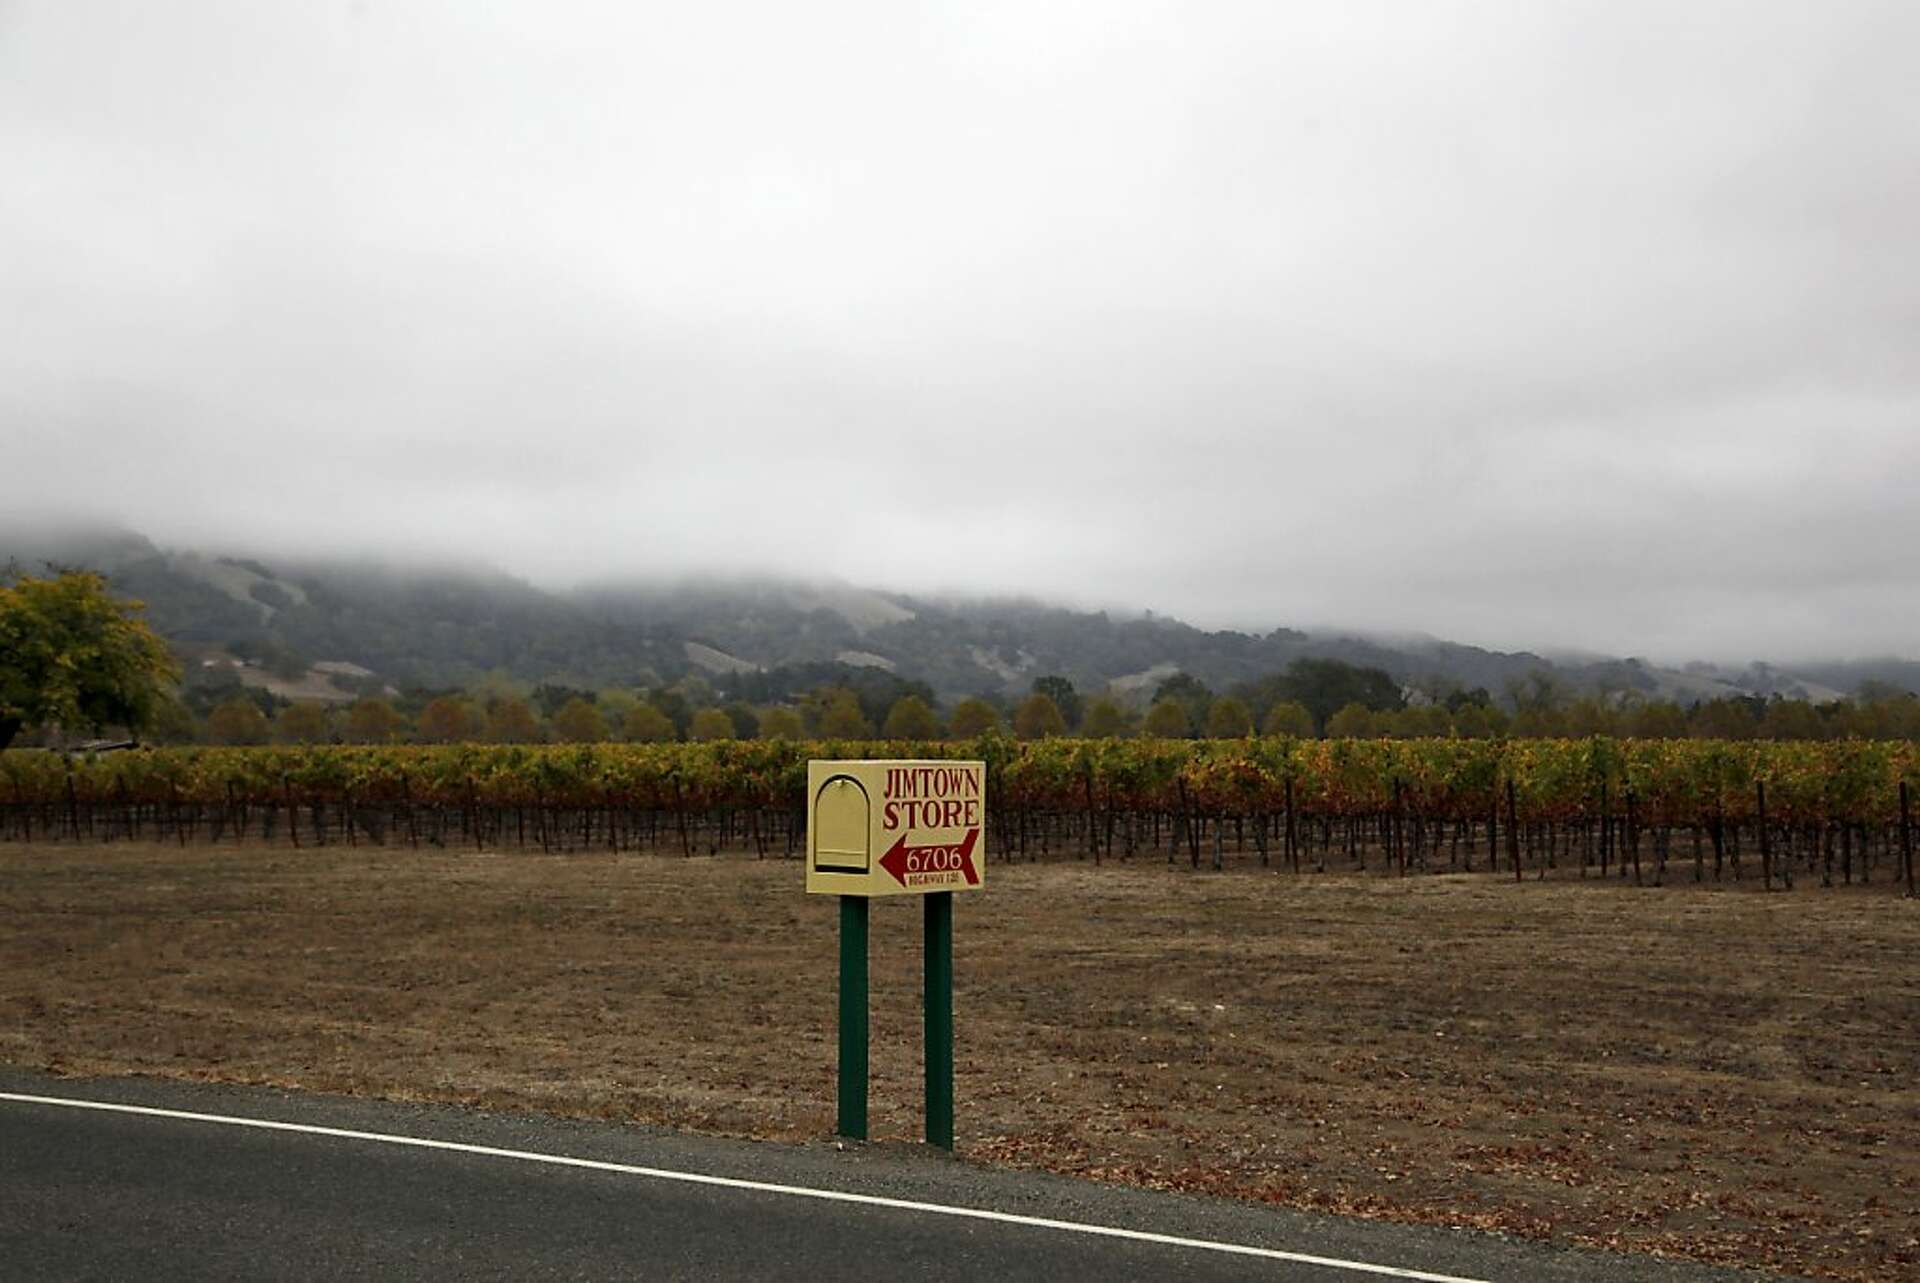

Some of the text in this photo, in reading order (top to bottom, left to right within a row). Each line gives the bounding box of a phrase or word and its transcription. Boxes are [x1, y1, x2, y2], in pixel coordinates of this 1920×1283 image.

[883, 768, 979, 798] JIMTOWN
[883, 800, 979, 829] STORE
[906, 847, 962, 871] 6706
